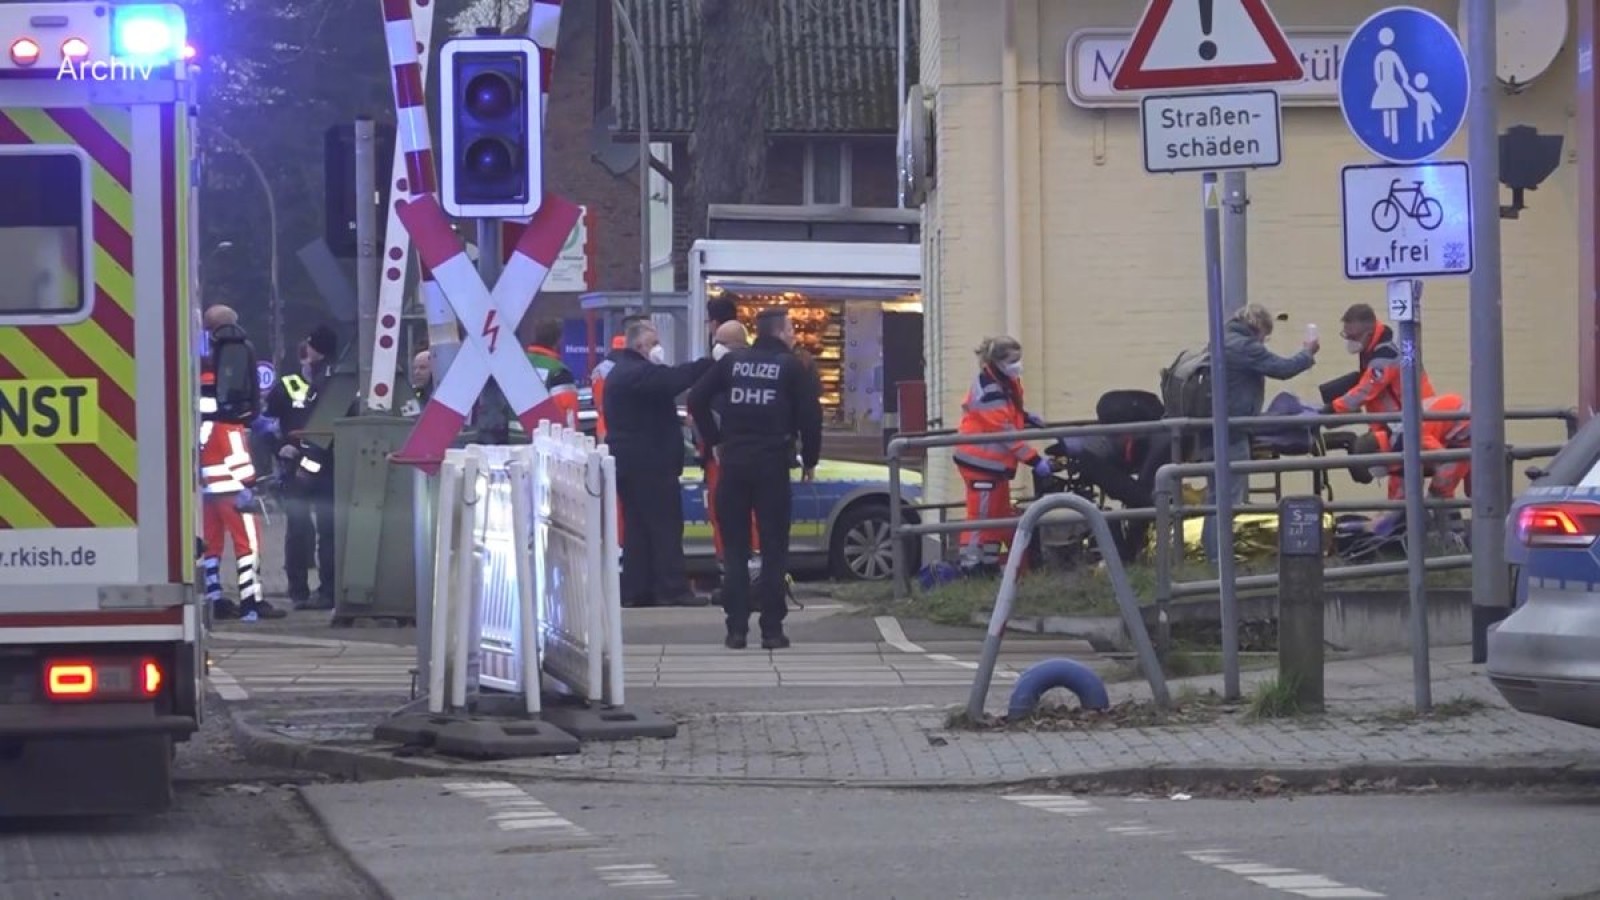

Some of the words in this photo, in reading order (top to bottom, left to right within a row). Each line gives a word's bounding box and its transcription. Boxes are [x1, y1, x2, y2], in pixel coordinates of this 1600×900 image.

[1161, 106, 1262, 129] Straßen-
[1166, 135, 1260, 159] schäden
[1390, 239, 1429, 263] frei
[732, 361, 780, 380] POLIZEI
[730, 387, 776, 405] DHF
[0, 385, 88, 438] NST
[0, 546, 97, 567] .rkish.de
